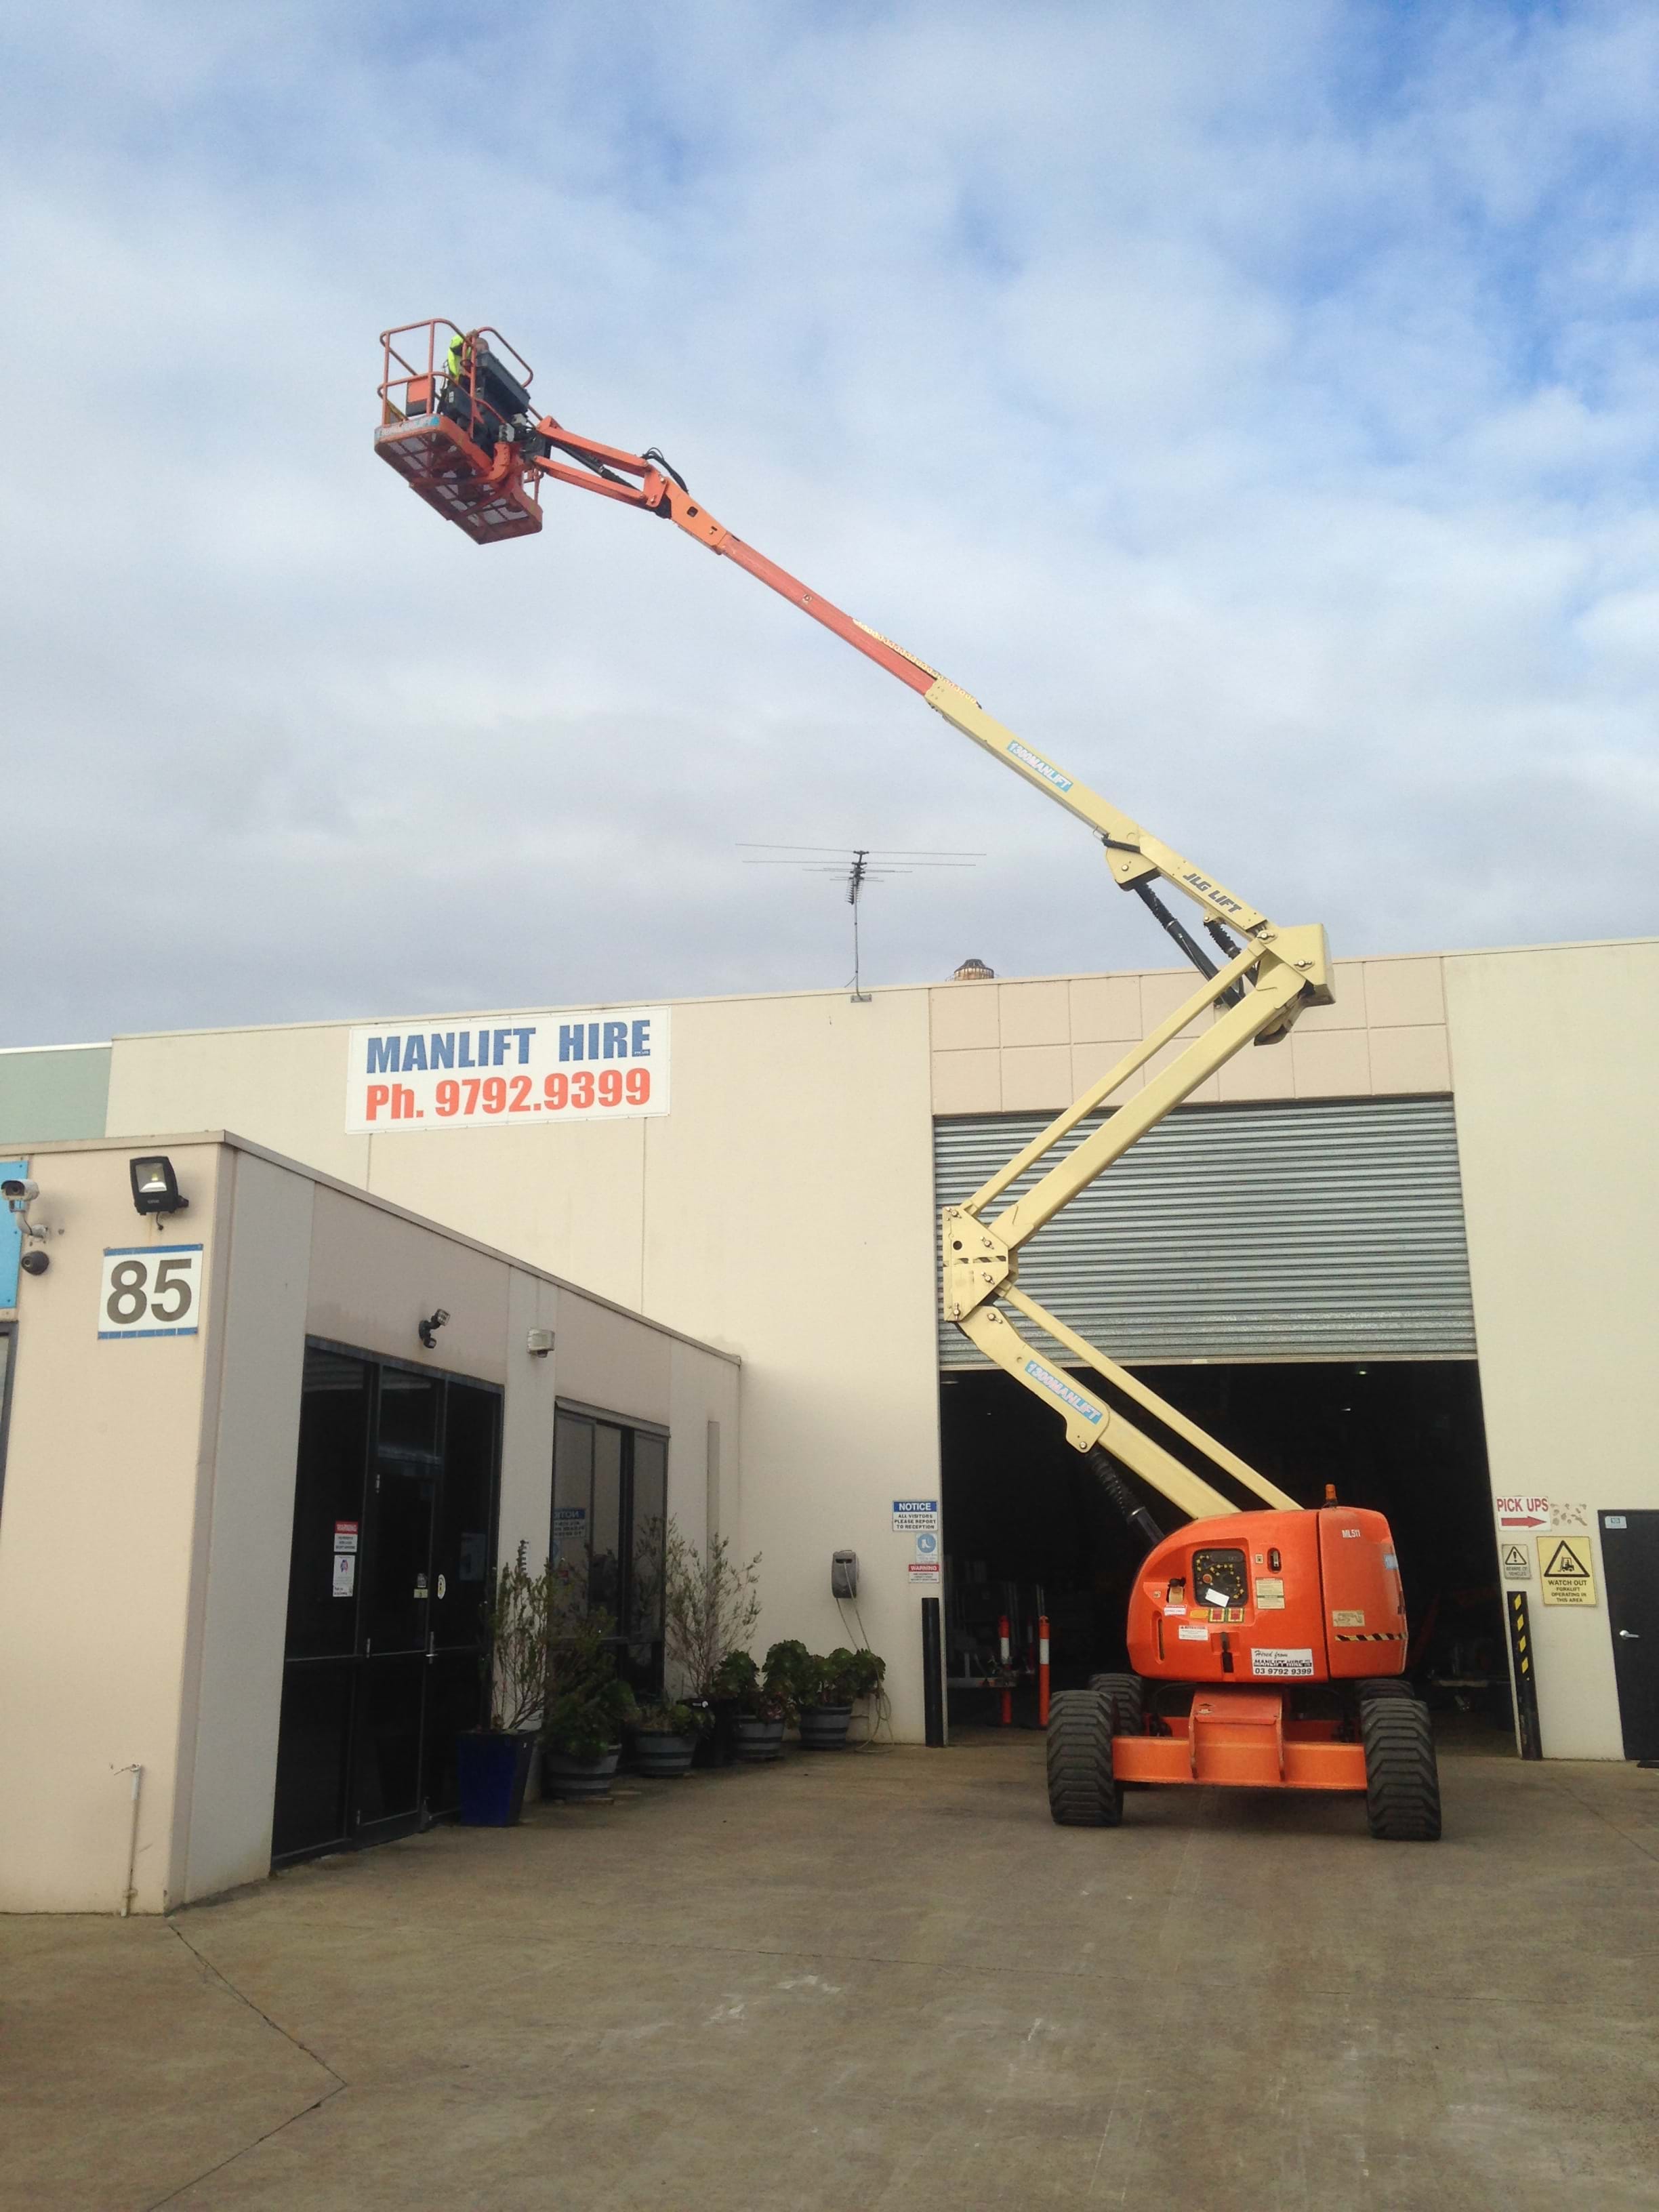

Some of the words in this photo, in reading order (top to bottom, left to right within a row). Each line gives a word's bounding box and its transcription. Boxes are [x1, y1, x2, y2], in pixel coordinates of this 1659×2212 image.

[1182, 873, 1212, 892] JLG
[1208, 890, 1242, 913] LIFT
[366, 1027, 536, 1073] MANLIFT
[559, 1020, 651, 1062] HIRE
[366, 1084, 424, 1121] Ph.
[436, 1067, 651, 1117] 9792.9399
[106, 1258, 192, 1324] 85
[899, 1502, 931, 1511] NOTICE
[1496, 1498, 1523, 1512] PICK
[1526, 1498, 1549, 1512] UPS
[1342, 1530, 1360, 1538] ML511
